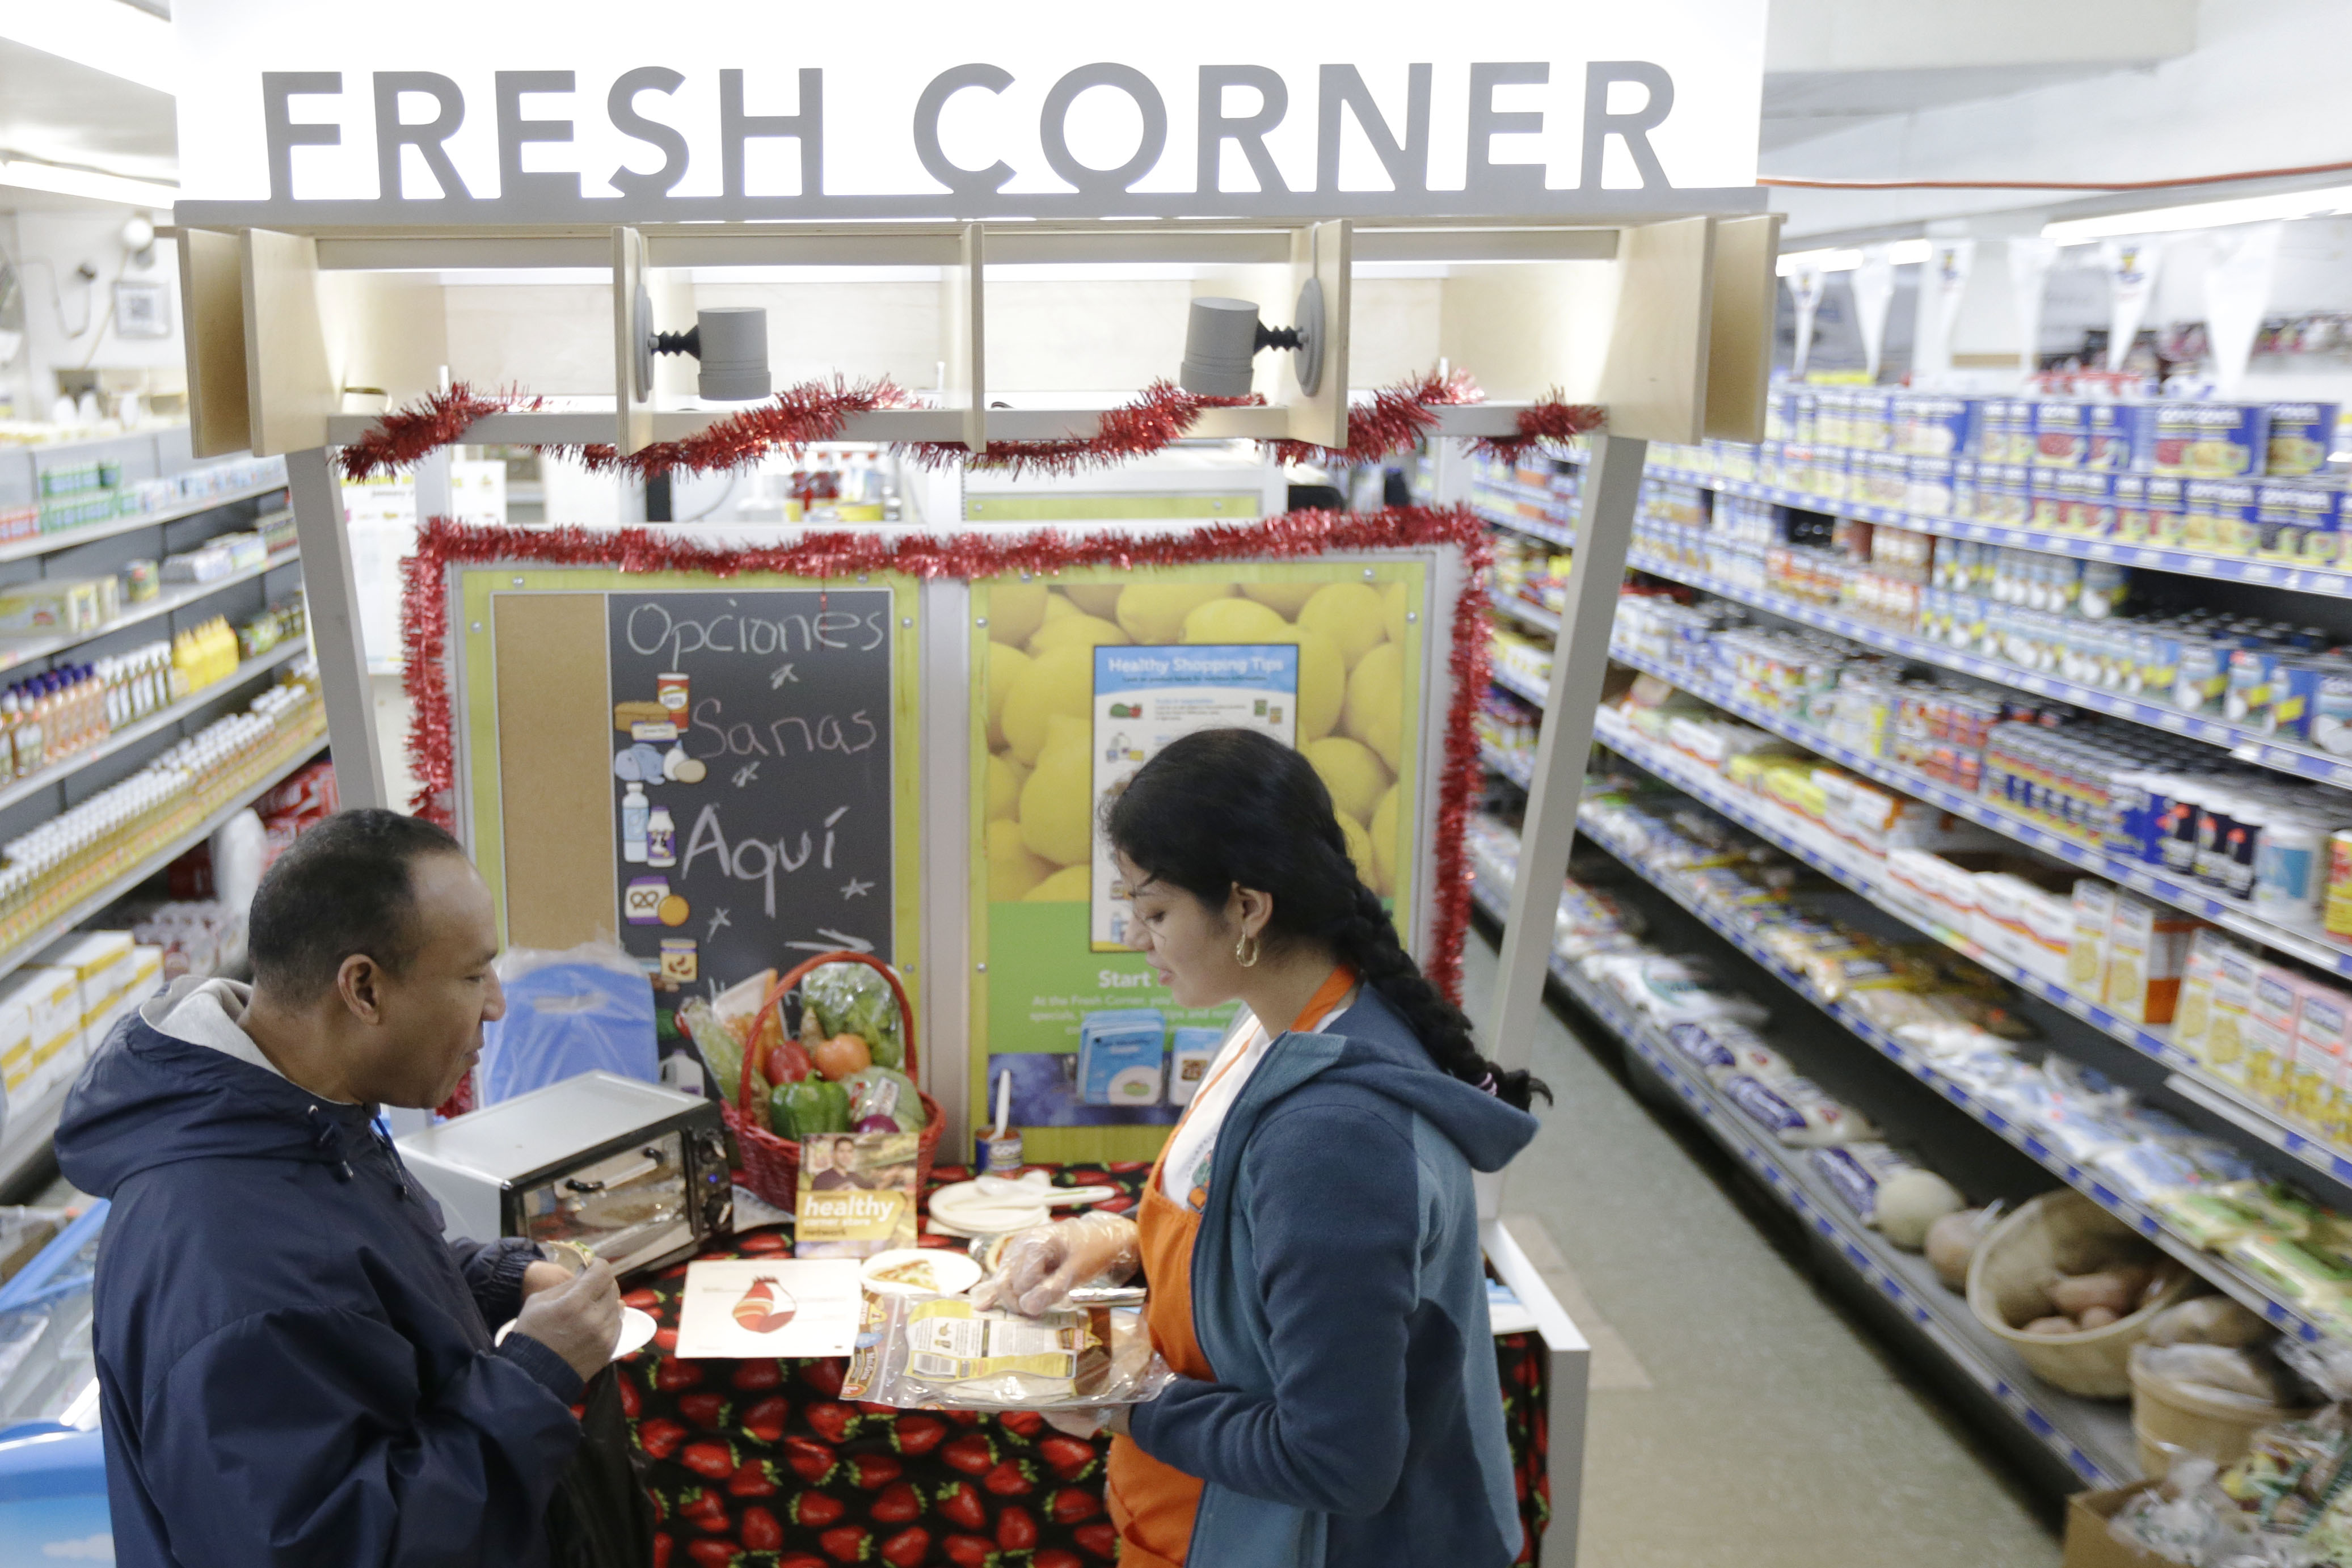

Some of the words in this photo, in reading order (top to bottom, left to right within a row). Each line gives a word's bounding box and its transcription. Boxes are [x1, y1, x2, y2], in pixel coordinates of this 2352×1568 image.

[262, 66, 825, 199] FRESH
[913, 61, 1676, 194] CORNER
[627, 598, 883, 672] Opciones
[1108, 657, 1169, 675] Healthy
[1173, 657, 1247, 674] Shopping
[1251, 656, 1284, 673] Tips
[692, 698, 876, 759] Sanas
[681, 803, 849, 918] Aquí
[1098, 970, 1152, 988] Start
[804, 1195, 895, 1222] healthy
